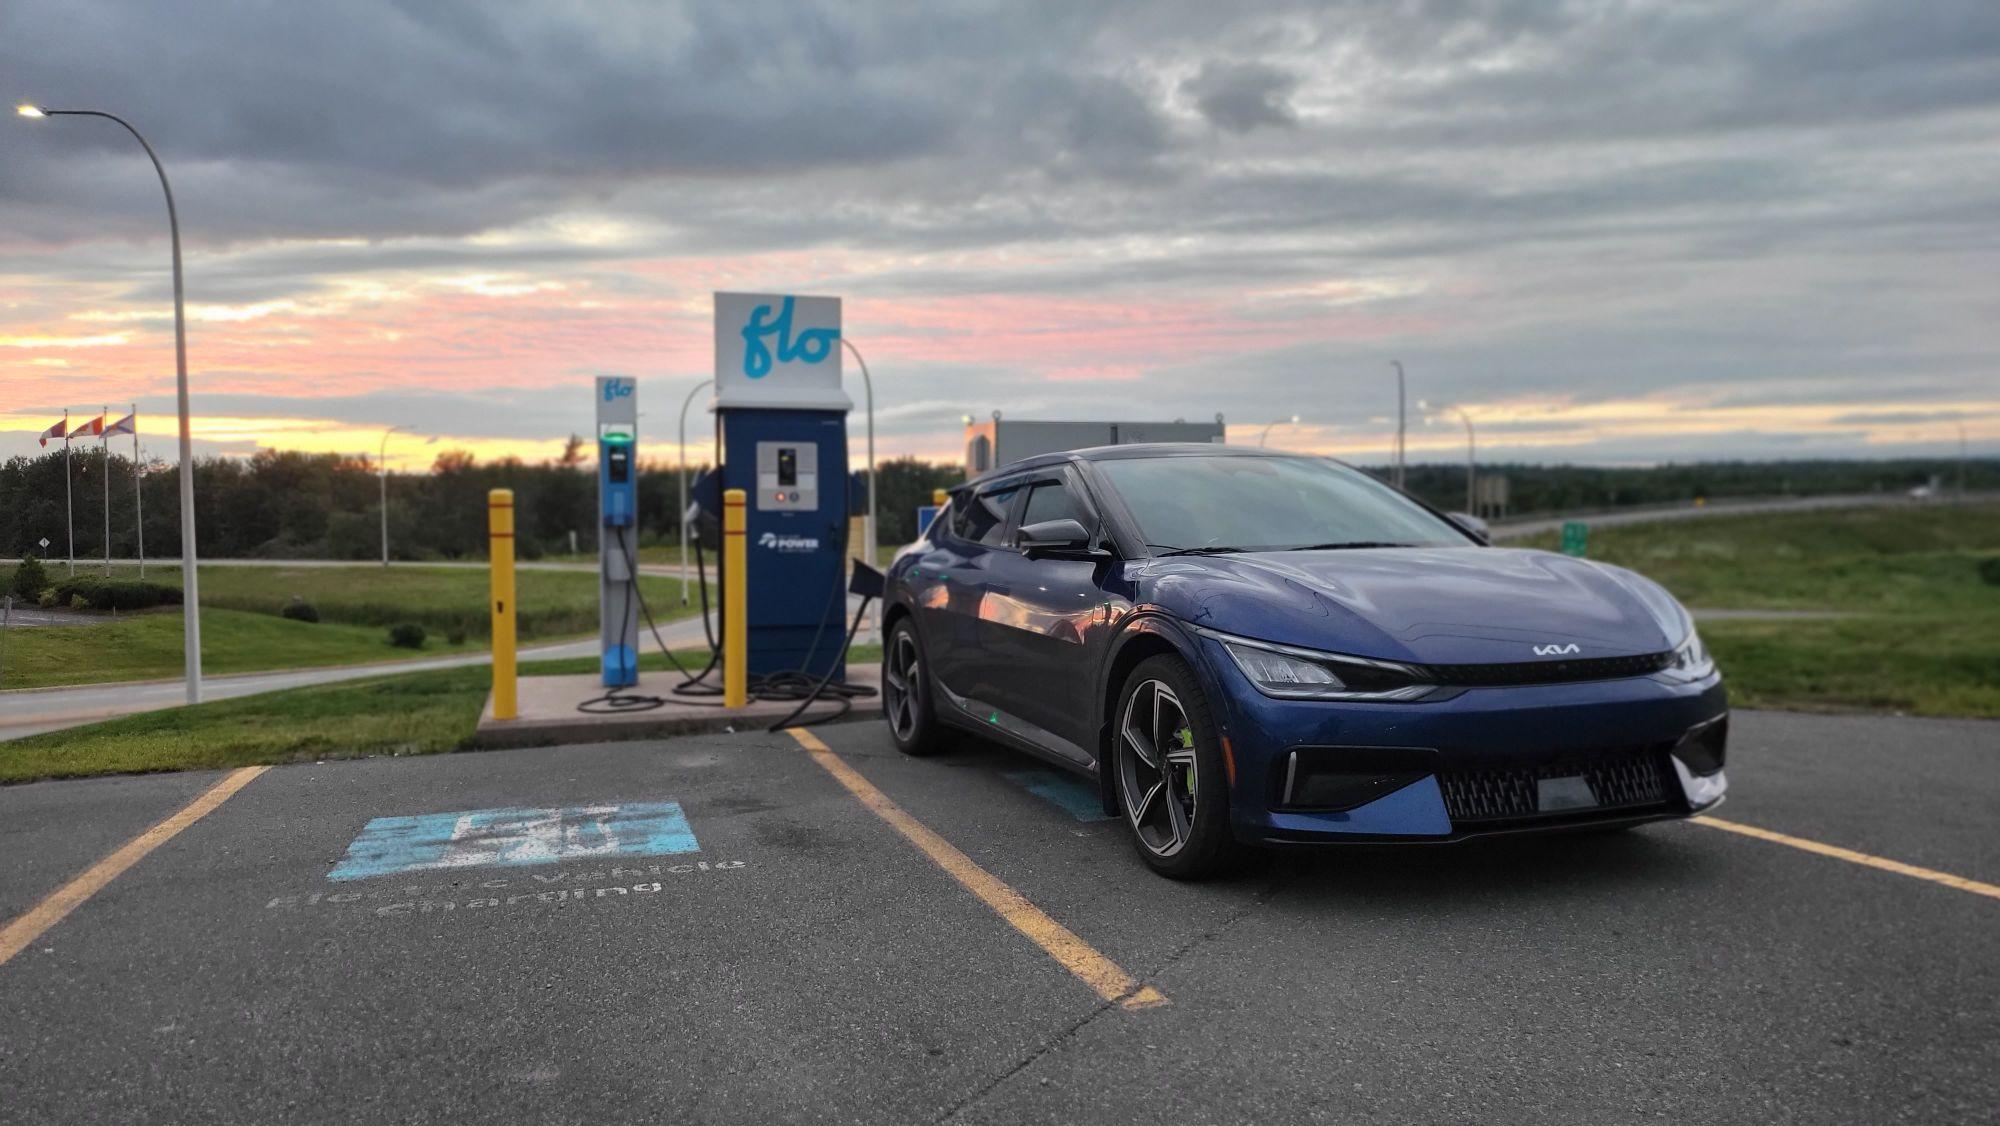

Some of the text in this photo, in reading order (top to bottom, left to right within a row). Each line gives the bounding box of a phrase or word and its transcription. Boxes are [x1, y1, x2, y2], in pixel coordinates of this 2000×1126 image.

[741, 295, 841, 379] flo
[604, 377, 633, 402] flo
[778, 538, 819, 548] POWER
[1532, 643, 1580, 656] KIA
